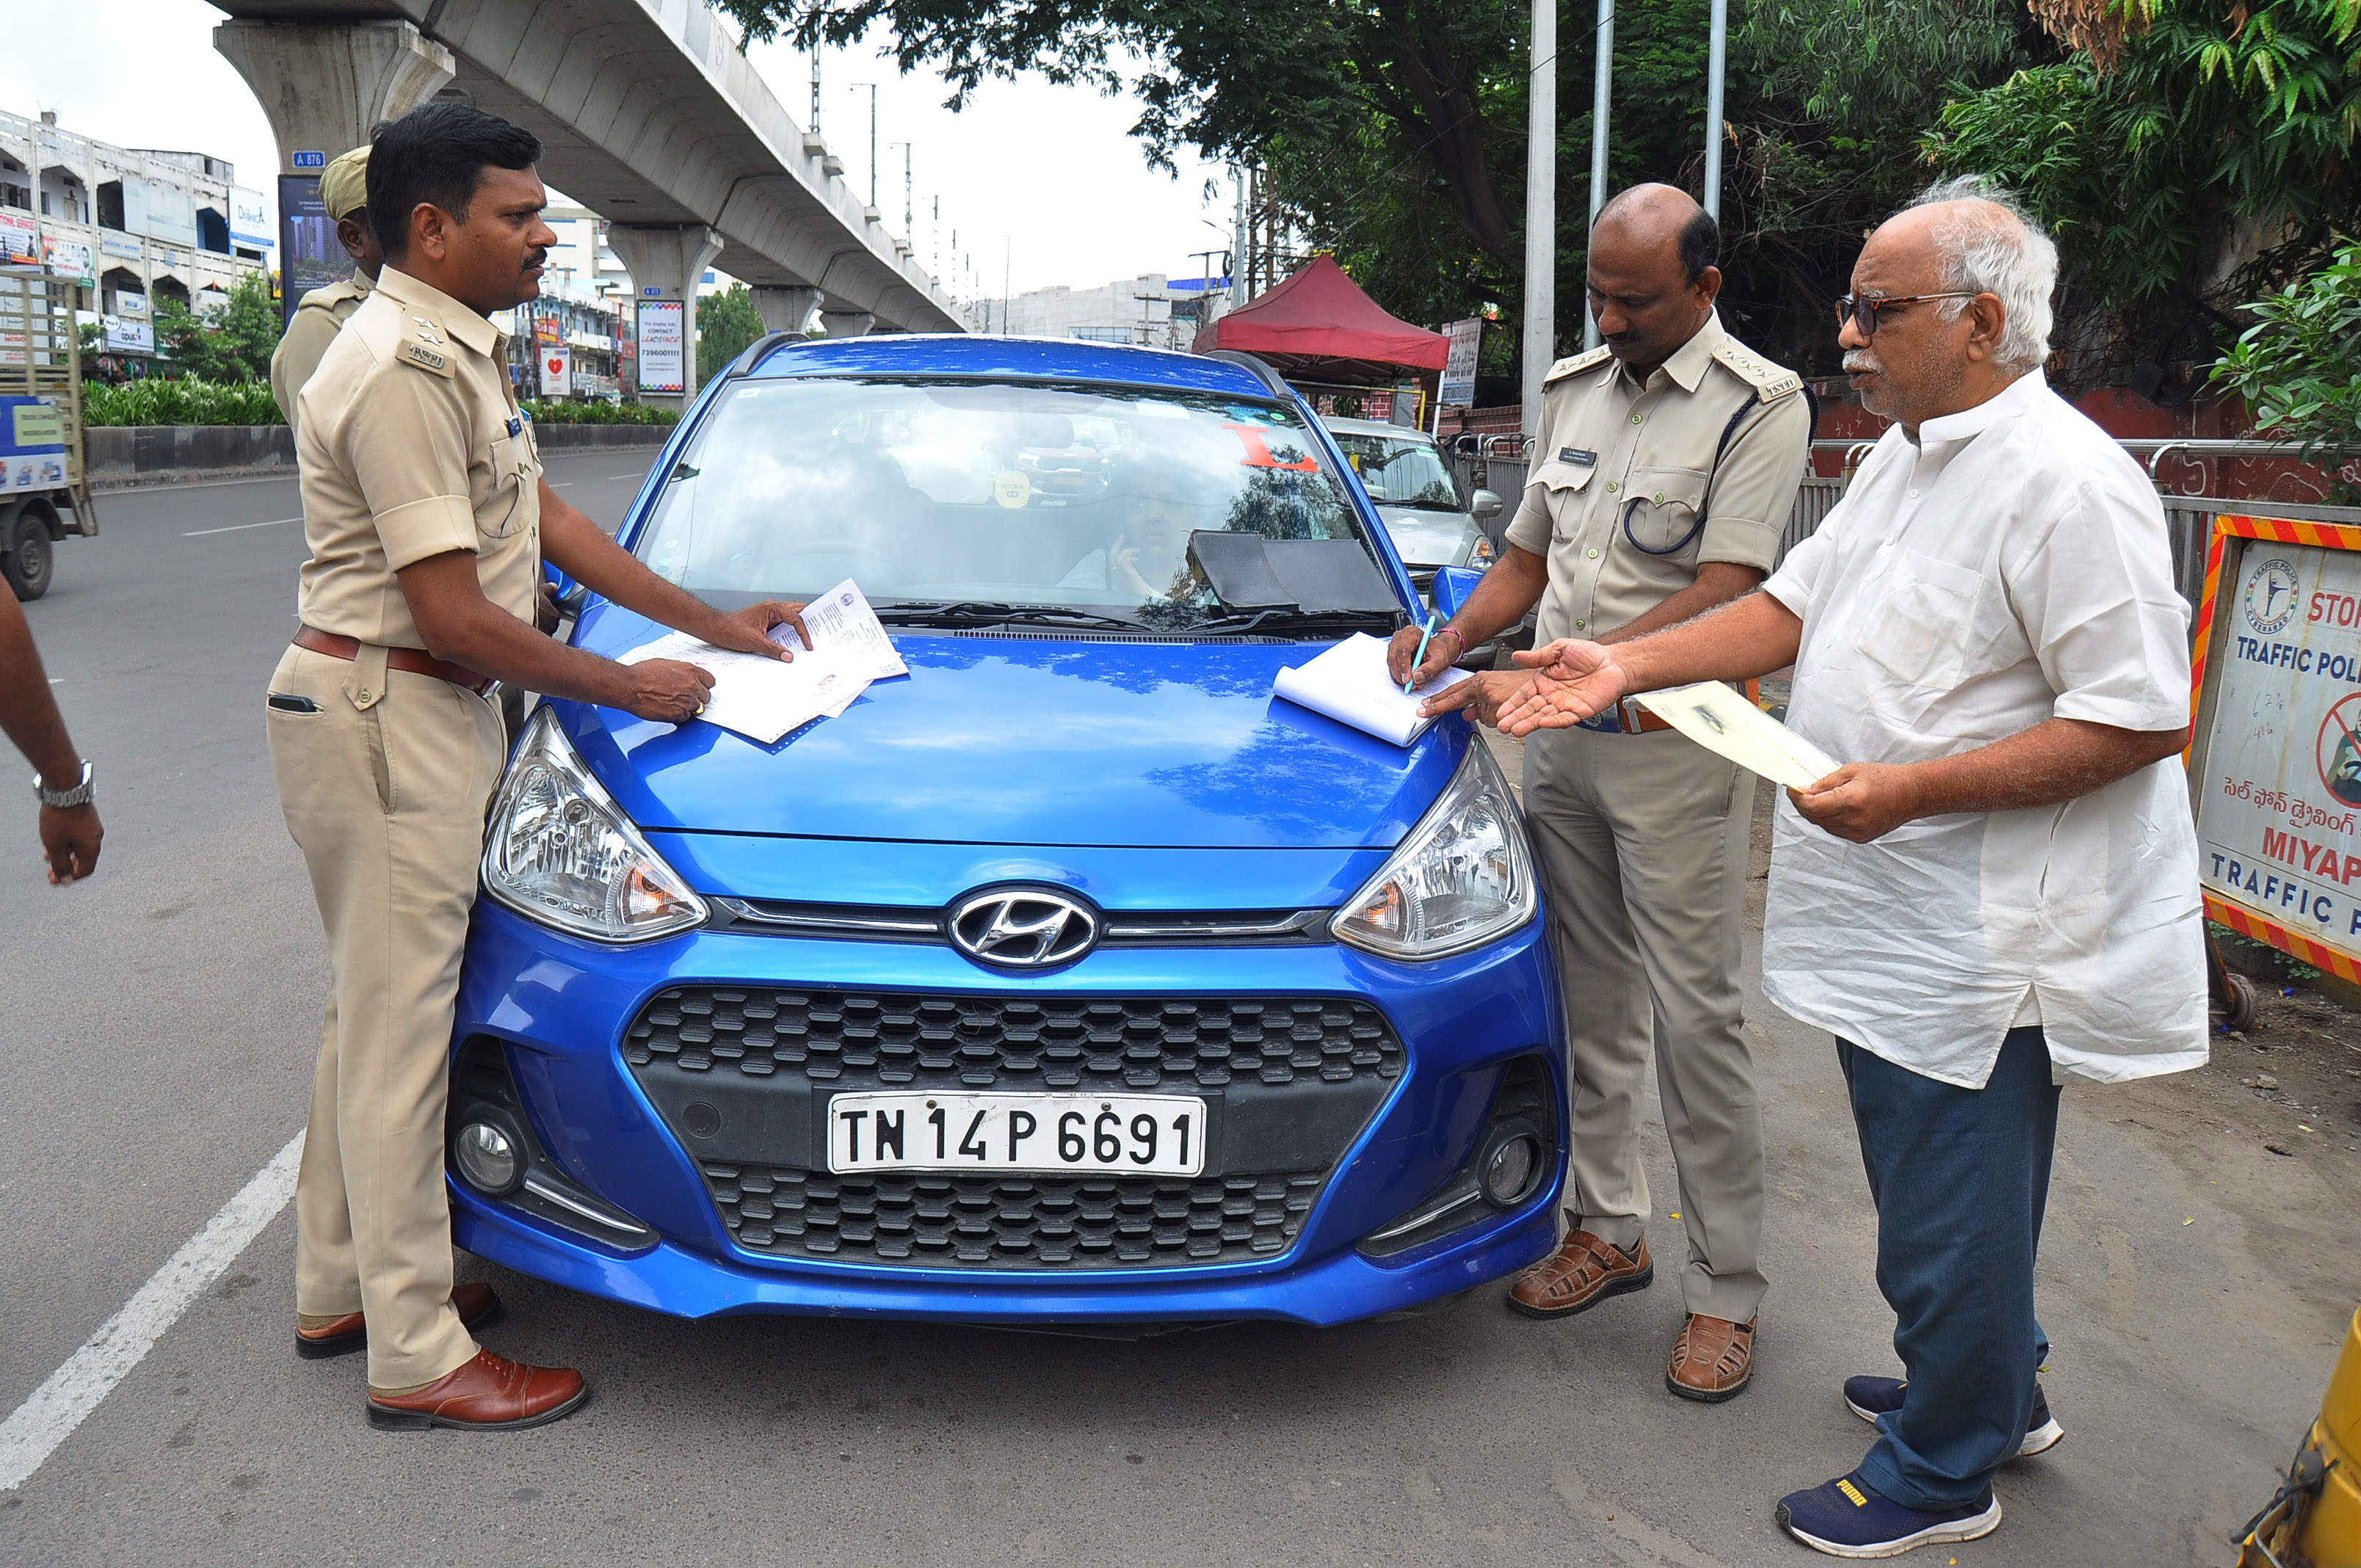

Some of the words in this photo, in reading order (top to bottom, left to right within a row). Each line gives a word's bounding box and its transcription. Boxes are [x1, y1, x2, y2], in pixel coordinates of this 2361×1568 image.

[297, 154, 303, 164] A
[307, 154, 321, 165] 876
[1222, 424, 1319, 473] L
[2253, 562, 2280, 581] TRAFFIC
[2280, 562, 2297, 586] POLICE
[2247, 610, 2288, 632] CYBERABAD
[2238, 636, 2313, 672] TRAFFIC
[2224, 777, 2253, 799] సెల్
[2254, 788, 2288, 813] ఫోన్
[2262, 827, 2361, 886] MIYAP
[2211, 852, 2333, 923] TRAFFIC
[840, 1109, 904, 1162] TN
[928, 1108, 987, 1161] 14
[1009, 1111, 1037, 1161] P
[1058, 1111, 1190, 1166] 6691
[1836, 1479, 1868, 1507] PUMA
